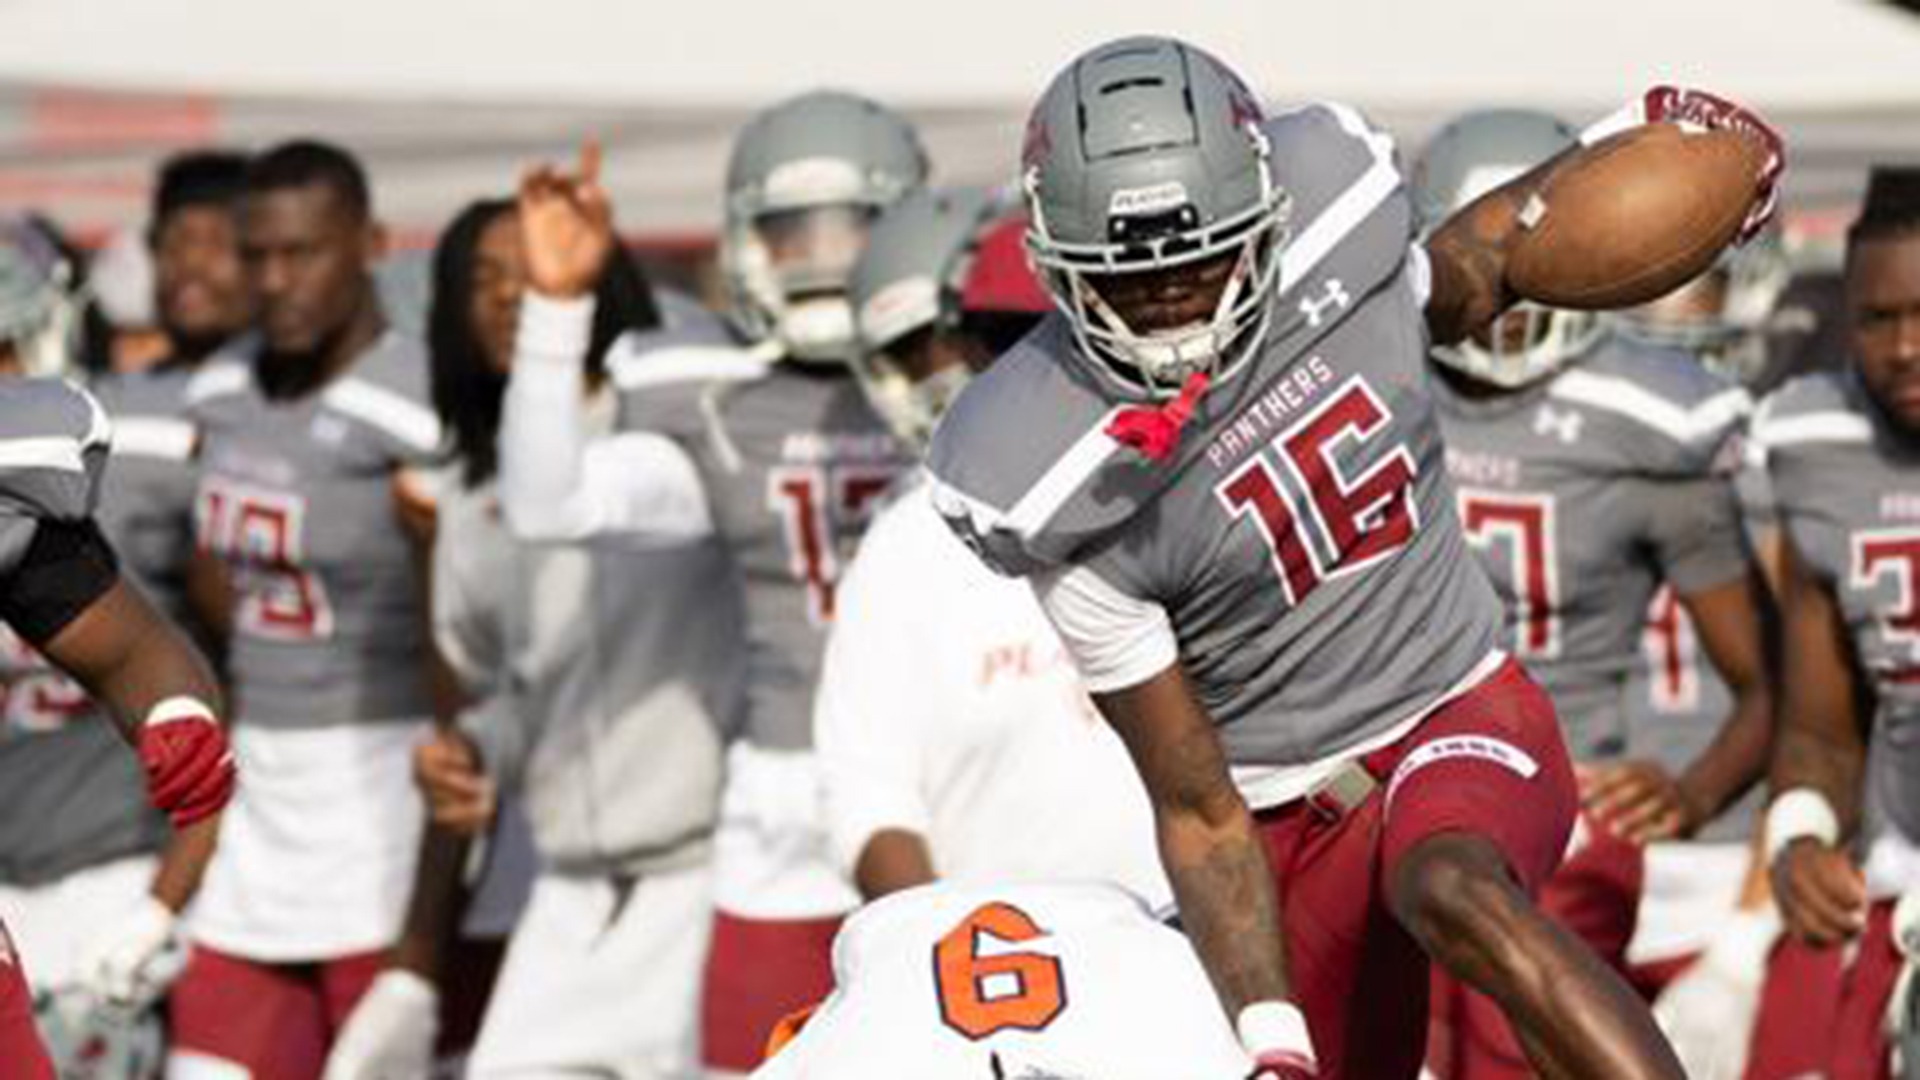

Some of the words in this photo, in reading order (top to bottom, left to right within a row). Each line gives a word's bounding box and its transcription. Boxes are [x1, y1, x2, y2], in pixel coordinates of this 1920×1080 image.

[1207, 355, 1334, 467] PANTHERS
[1213, 373, 1420, 606] 16
[932, 900, 1068, 1041] 6
